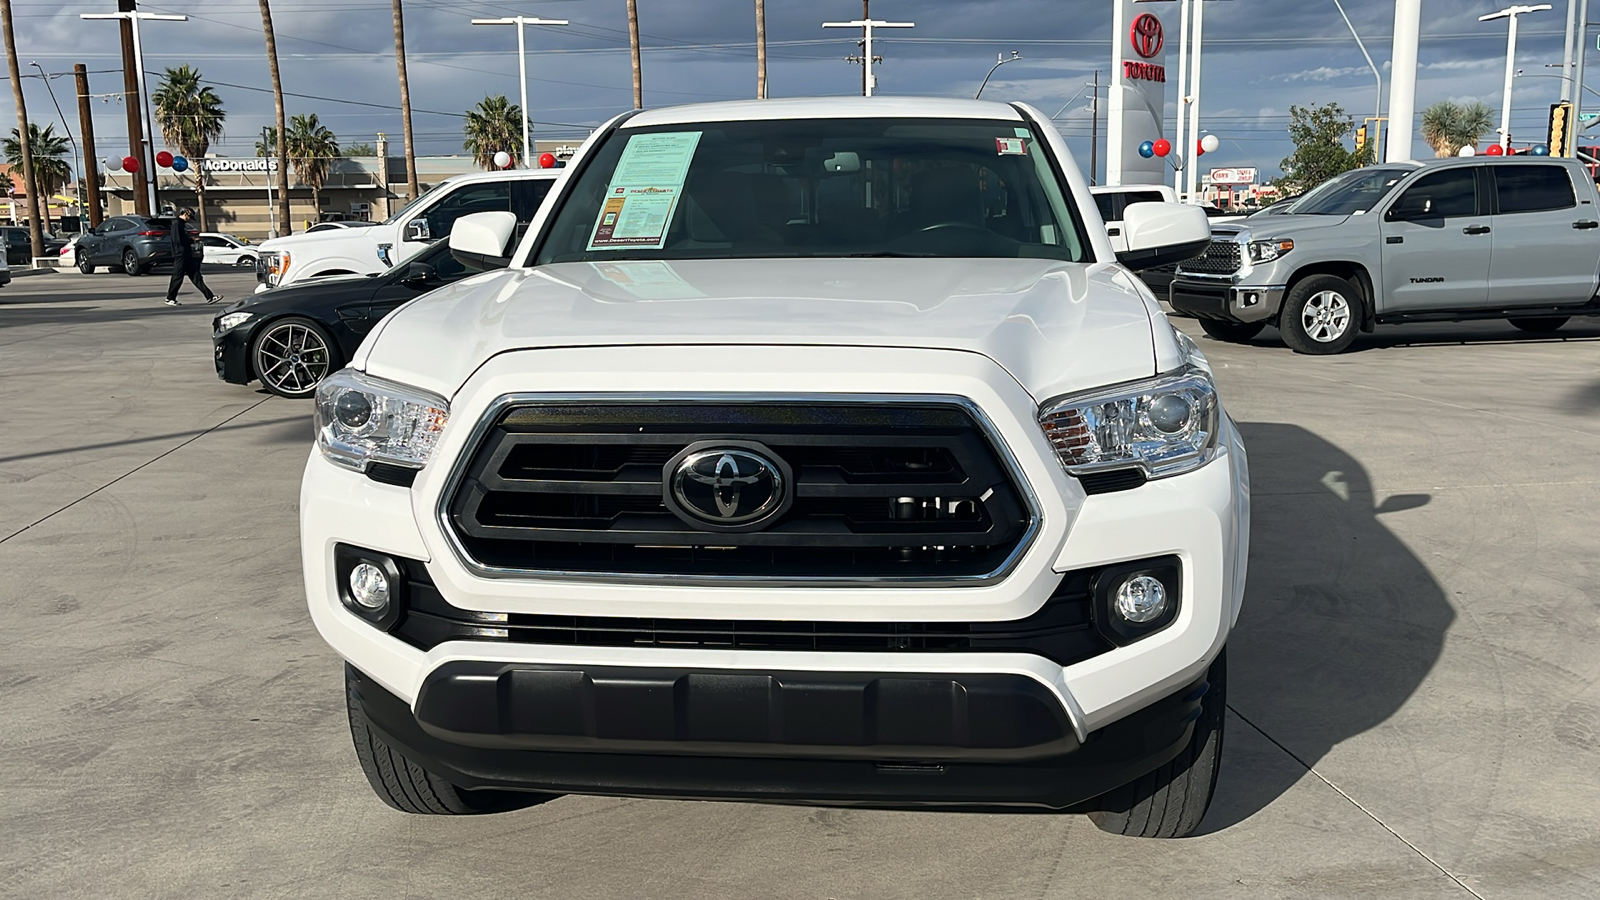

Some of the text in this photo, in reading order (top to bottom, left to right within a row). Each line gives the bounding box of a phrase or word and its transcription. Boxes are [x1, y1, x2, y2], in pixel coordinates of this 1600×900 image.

[1123, 61, 1166, 83] TOYOTA
[204, 160, 277, 170] McDonalds
[1409, 276, 1445, 284] TUNDRA
